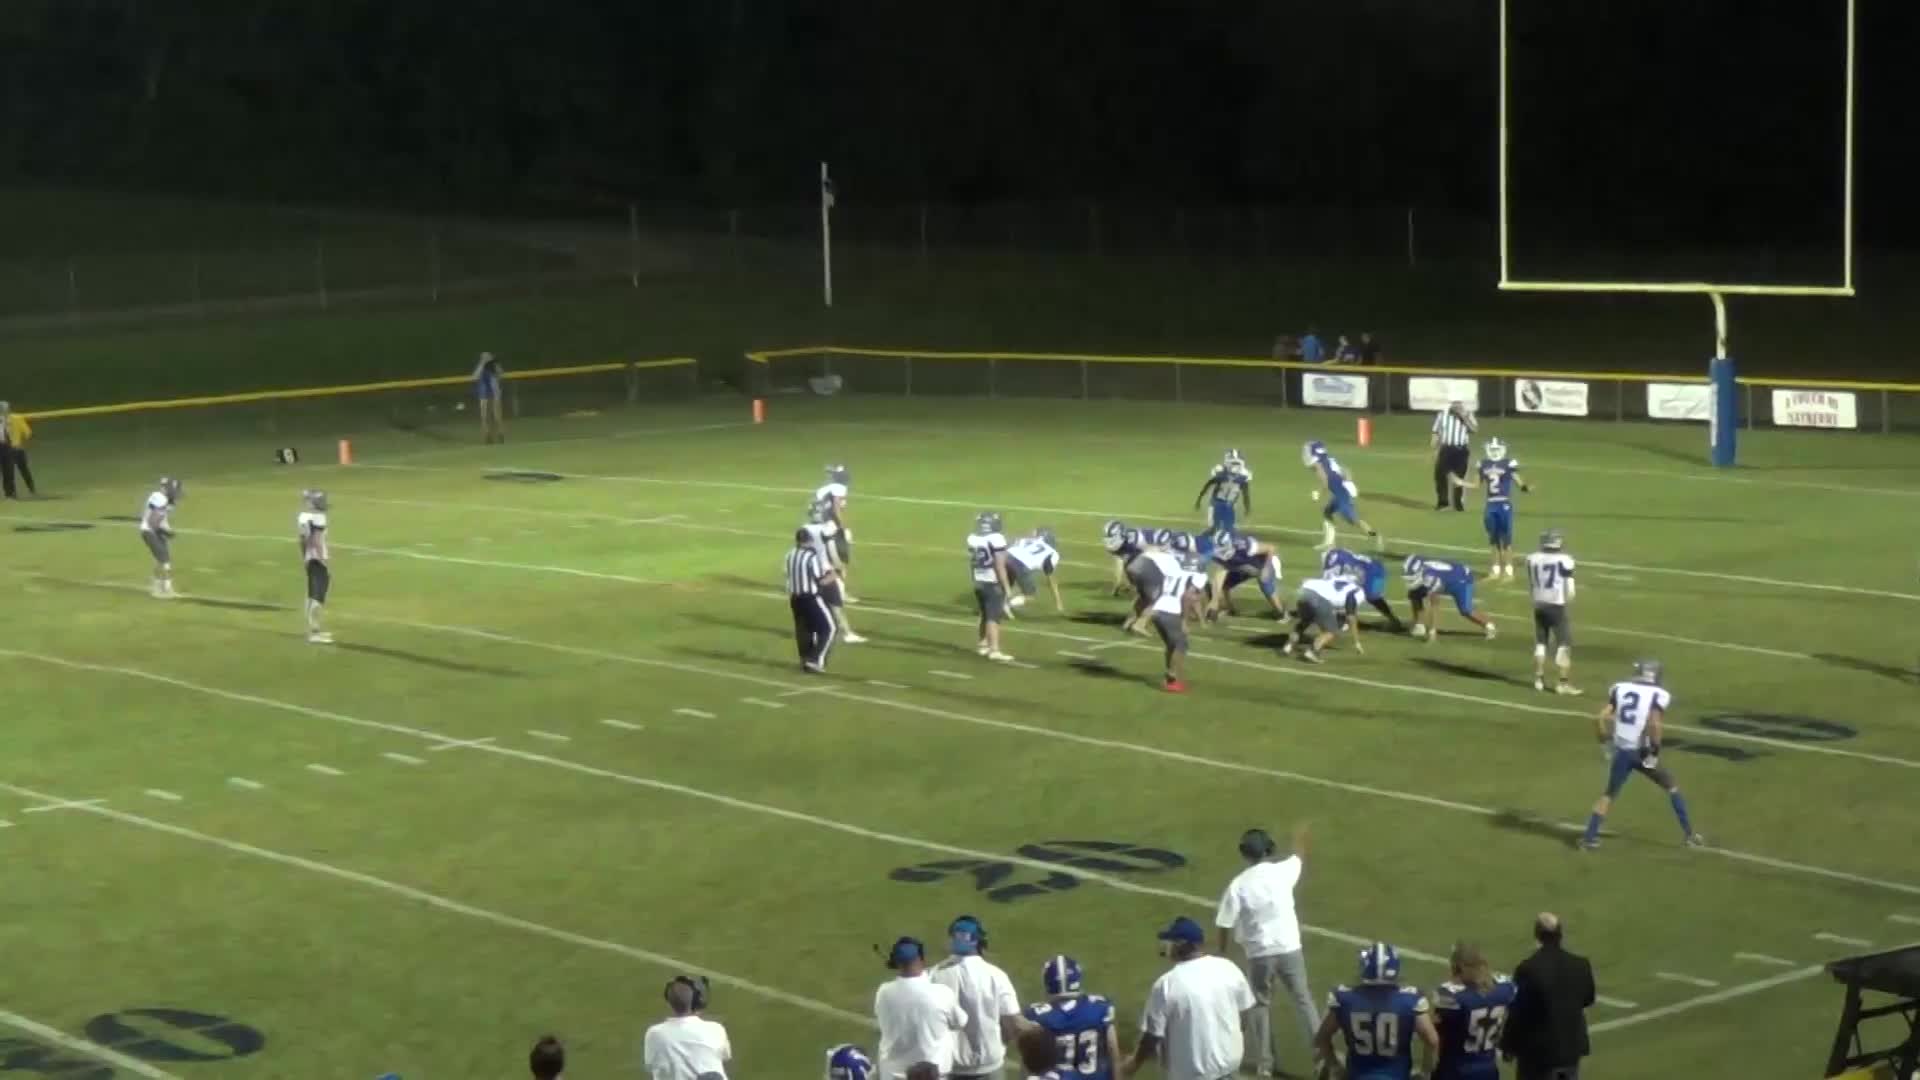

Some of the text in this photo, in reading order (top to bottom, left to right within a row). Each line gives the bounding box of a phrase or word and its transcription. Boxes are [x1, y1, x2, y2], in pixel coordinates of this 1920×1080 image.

[1533, 563, 1556, 589] 17
[1620, 691, 1641, 726] 2
[889, 840, 1187, 903] 20
[1350, 1011, 1398, 1057] 50
